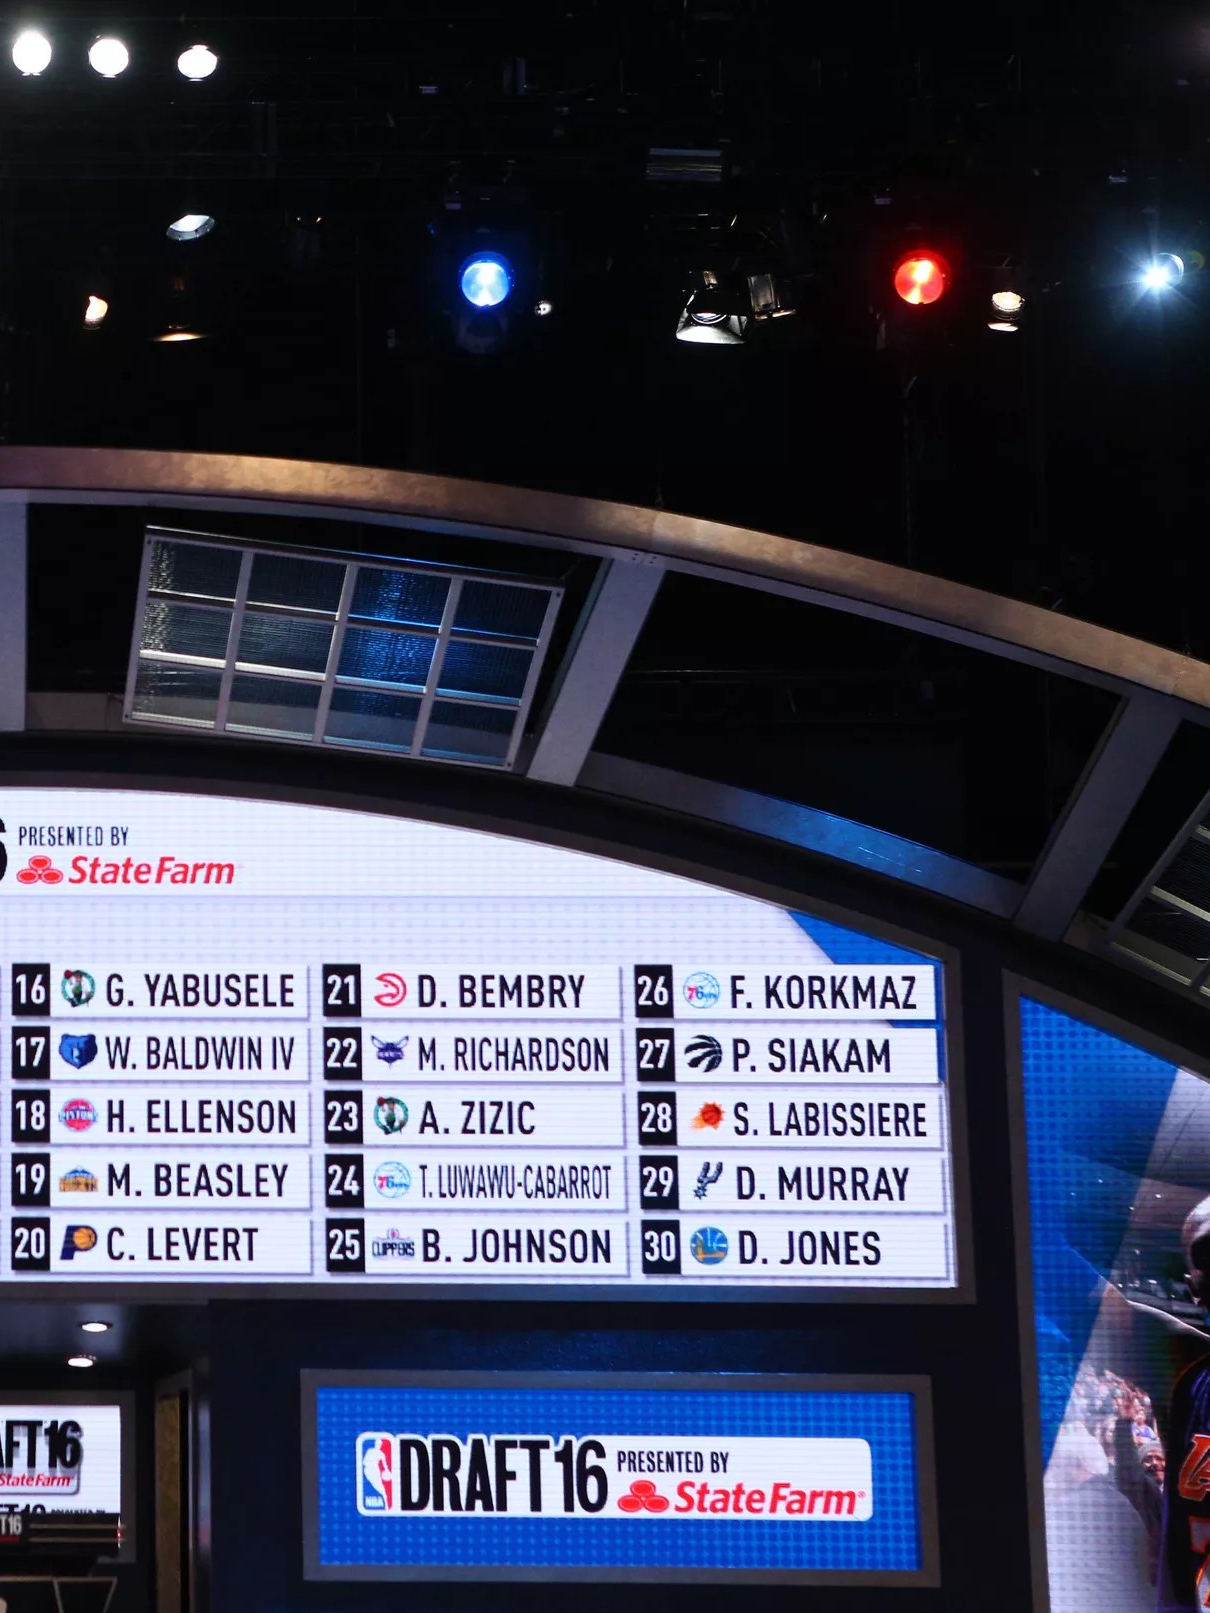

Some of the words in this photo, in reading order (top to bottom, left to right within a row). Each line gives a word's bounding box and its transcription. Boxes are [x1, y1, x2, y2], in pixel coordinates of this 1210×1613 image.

[18, 826, 103, 847] PRESENTED
[110, 826, 128, 846] BY
[15, 973, 46, 1005] 16
[106, 973, 134, 1007] G.
[144, 973, 294, 1008] YABUSELE
[327, 974, 356, 1005] 21
[418, 974, 447, 1008] D.
[458, 974, 585, 1009] BEMBRY
[637, 975, 669, 1006] 26
[730, 975, 752, 1009] F.
[764, 974, 917, 1010] KORKMAZ
[15, 1036, 46, 1067] 17
[105, 1036, 137, 1070] W.
[146, 1036, 262, 1070] BALDWIN
[272, 1036, 295, 1071] IV
[326, 1037, 358, 1068] 22
[418, 1037, 445, 1071] M.
[454, 1037, 609, 1072] RICHARDSON
[639, 1038, 670, 1069] 27
[732, 1038, 756, 1073] P.
[768, 1037, 891, 1073] SIAKAM
[15, 1099, 46, 1131] 18
[107, 1099, 135, 1133] H.
[147, 1099, 296, 1134] ELLENSON
[327, 1100, 359, 1132] 23
[419, 1100, 450, 1135] A.
[461, 1100, 535, 1135] ZIZIC
[640, 1102, 672, 1133] 28
[733, 1101, 758, 1136] S.
[768, 1102, 927, 1137] LABISSIERE
[15, 1163, 46, 1195] 19
[107, 1163, 142, 1197] M.
[154, 1163, 289, 1198] BEASLEY
[328, 1164, 360, 1196] 24
[419, 1164, 433, 1198] T.
[438, 1164, 612, 1200] LUWAWU-CABARROT
[642, 1166, 674, 1197] 29
[736, 1166, 766, 1200] D.
[778, 1166, 909, 1202] MURRAY
[14, 1227, 46, 1259] 20
[107, 1226, 135, 1261] C.
[147, 1227, 259, 1262] LEVERT
[328, 1228, 360, 1260] 25
[422, 1228, 452, 1263] B.
[462, 1228, 611, 1264] JOHNSON
[644, 1230, 676, 1262] 30
[738, 1230, 768, 1265] D.
[779, 1230, 881, 1266] JONES
[617, 1450, 704, 1473] PRESENTED
[710, 1451, 729, 1474] BY
